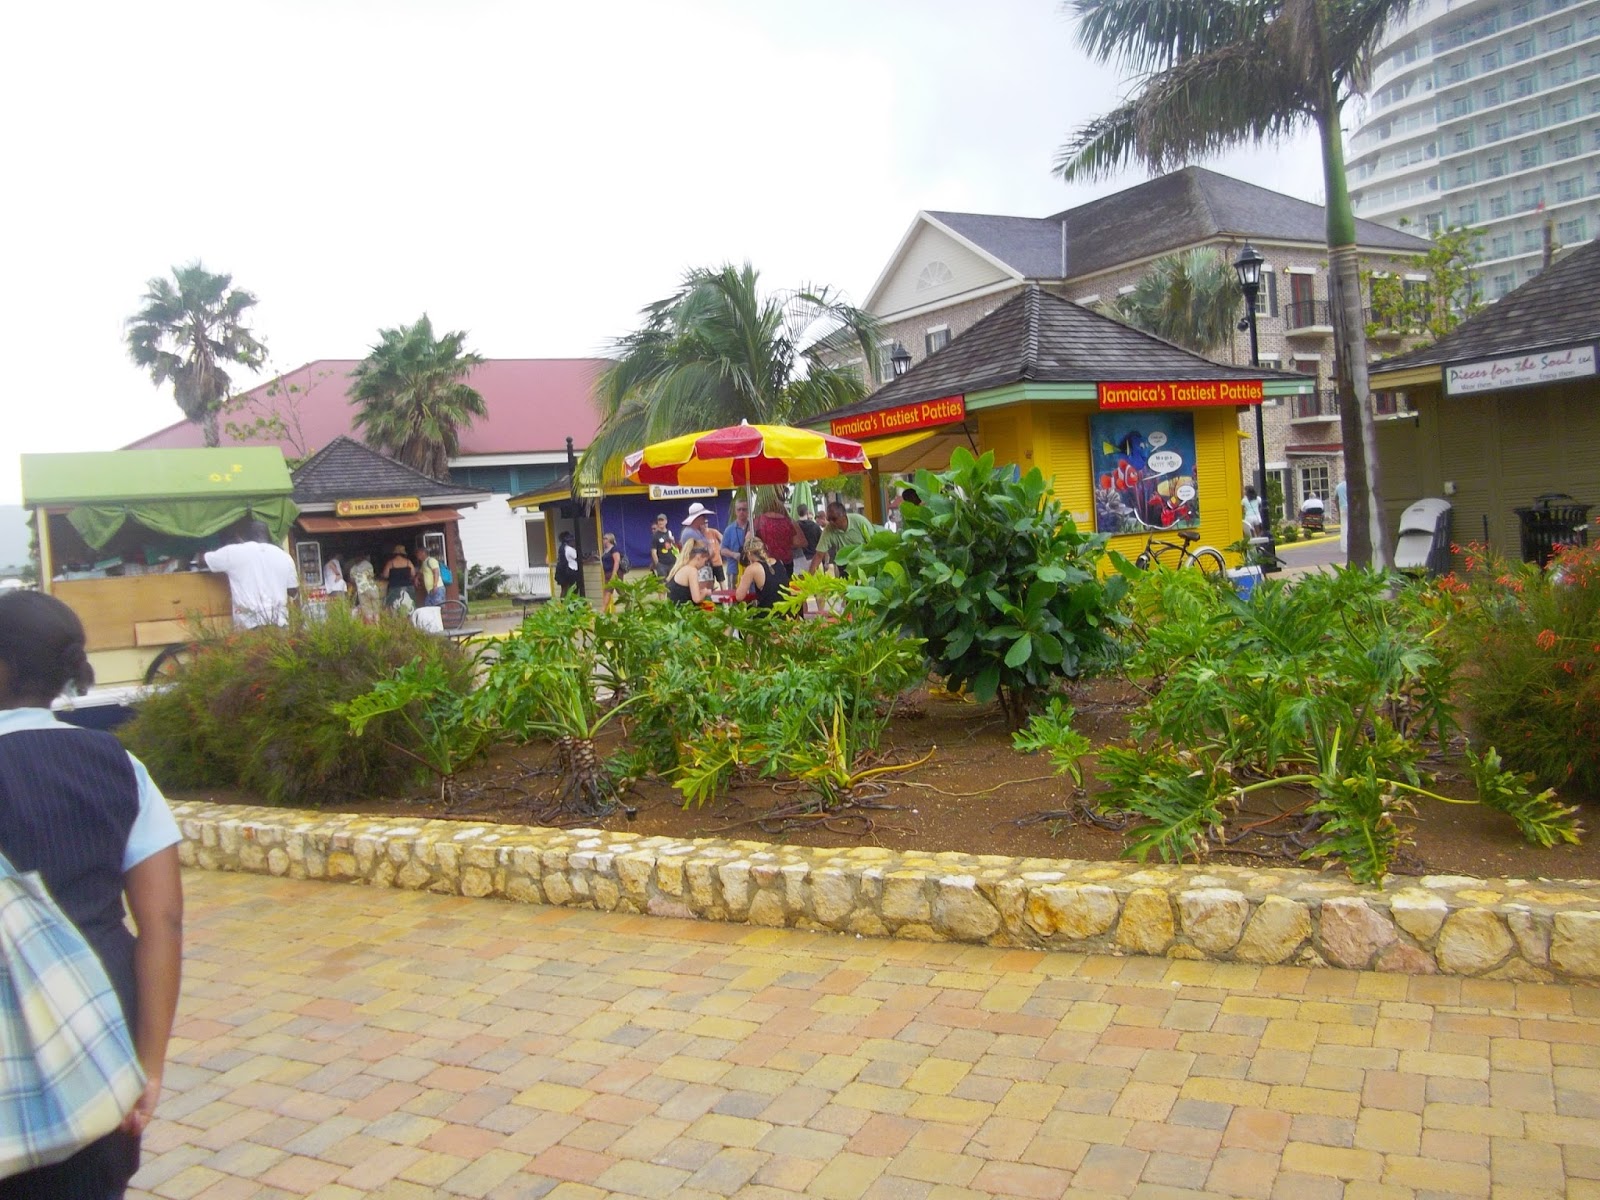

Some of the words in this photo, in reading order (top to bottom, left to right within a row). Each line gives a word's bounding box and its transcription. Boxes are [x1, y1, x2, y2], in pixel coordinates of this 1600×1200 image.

[1450, 369, 1488, 384] Pieces
[1490, 362, 1512, 380] for
[1514, 357, 1537, 372] the
[1541, 351, 1573, 369] Soul
[1102, 384, 1167, 405] Jamaica's
[1169, 384, 1217, 401] Tastiest
[1219, 383, 1262, 400] Patties
[832, 414, 878, 437] Jamaica's
[879, 408, 919, 428] Tastiest
[921, 401, 962, 421] Patties
[354, 503, 379, 511] ISLAND
